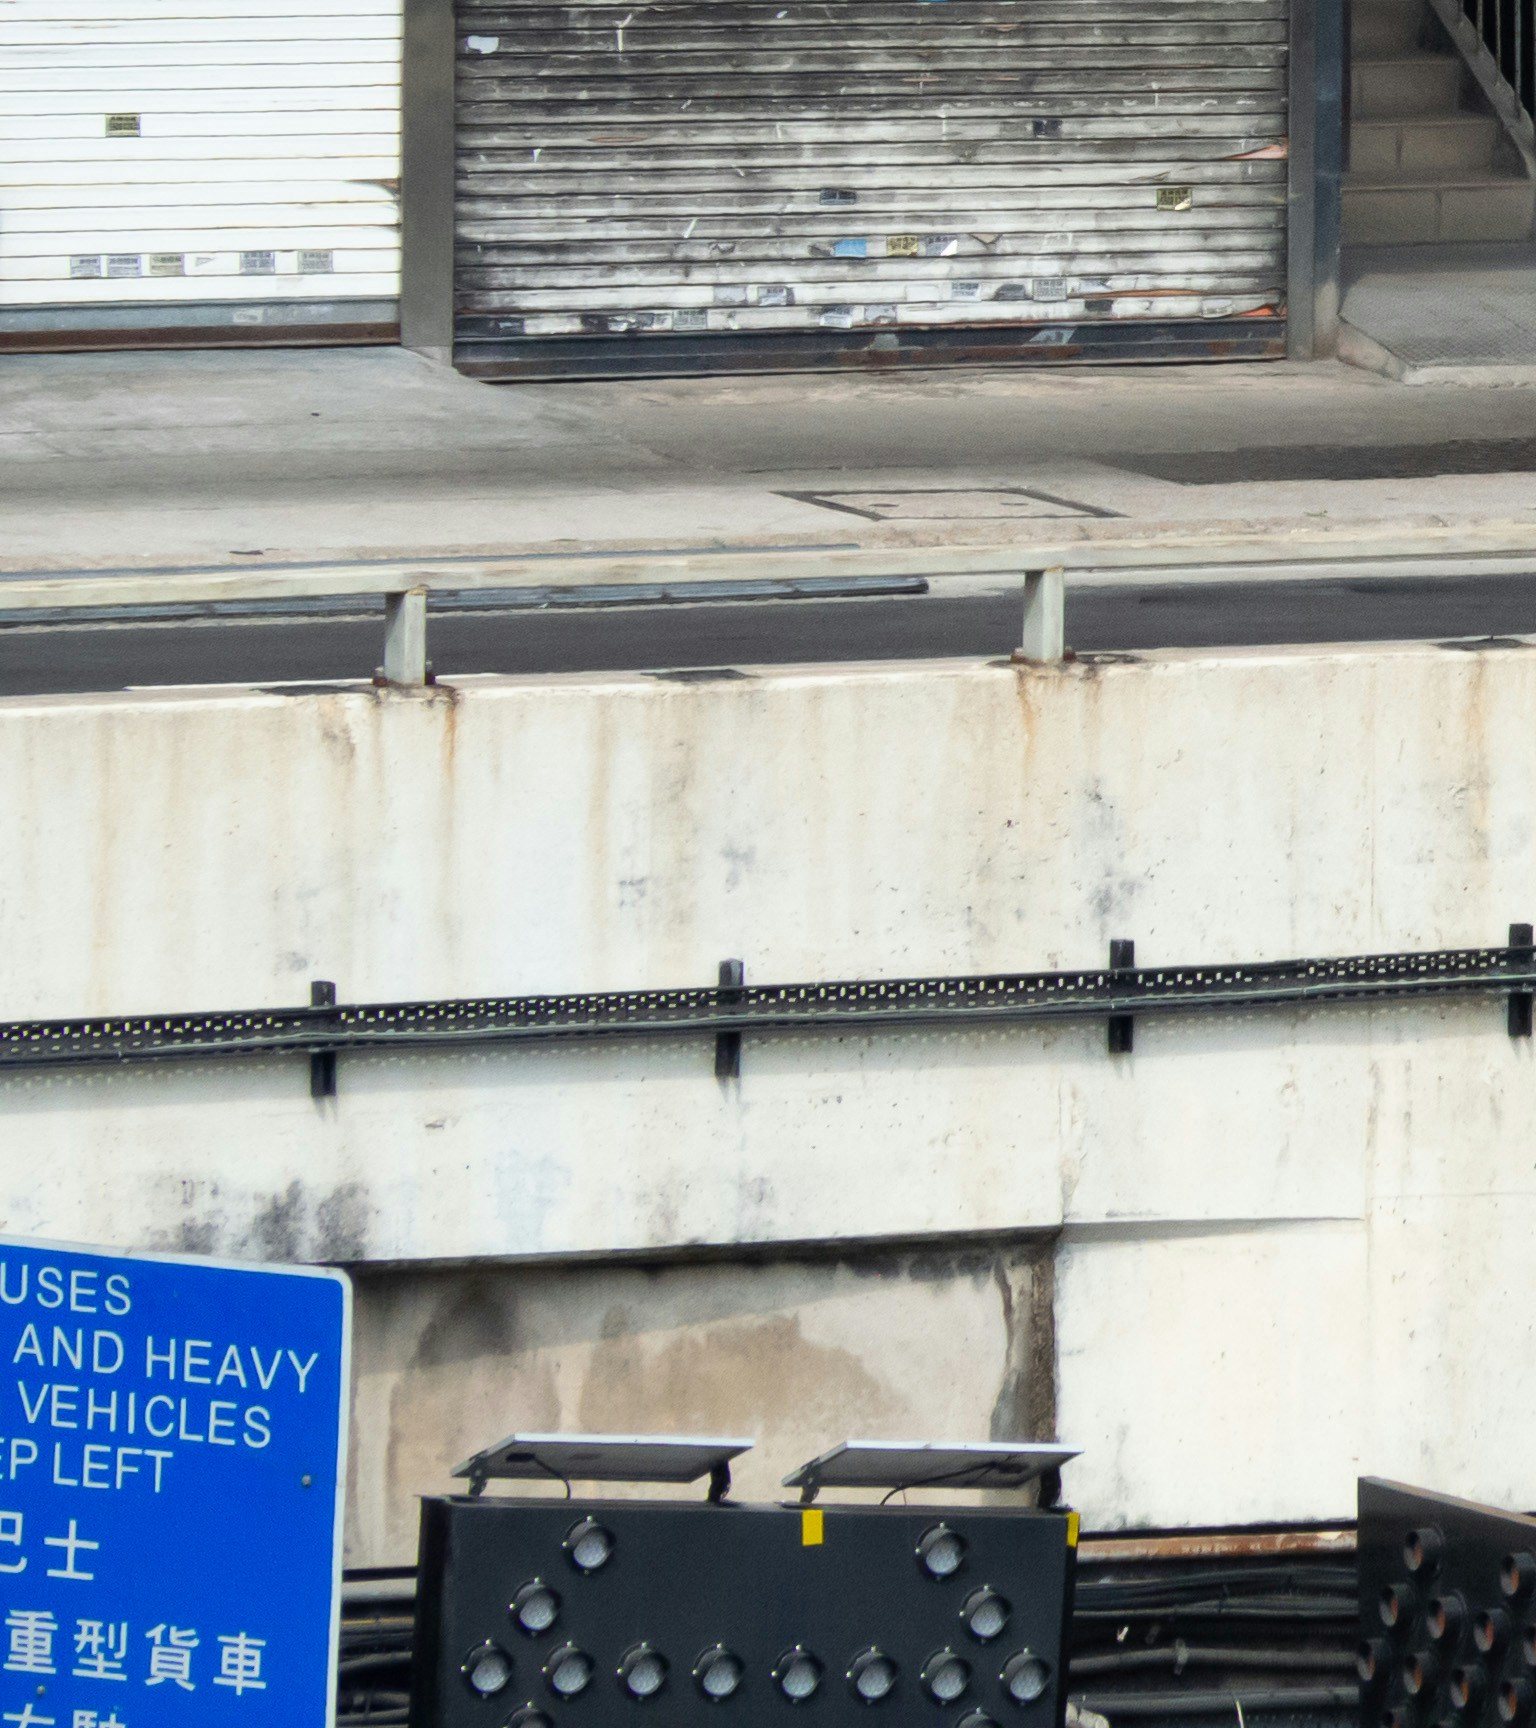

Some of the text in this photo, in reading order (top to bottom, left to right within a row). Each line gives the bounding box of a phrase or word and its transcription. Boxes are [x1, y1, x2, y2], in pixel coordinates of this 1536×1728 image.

[13, 1323, 318, 1393] AND HEAVY
[18, 1381, 272, 1449] VEHICLES
[53, 1442, 174, 1493] LEFT
[3, 1610, 267, 1696] 重型貨車
